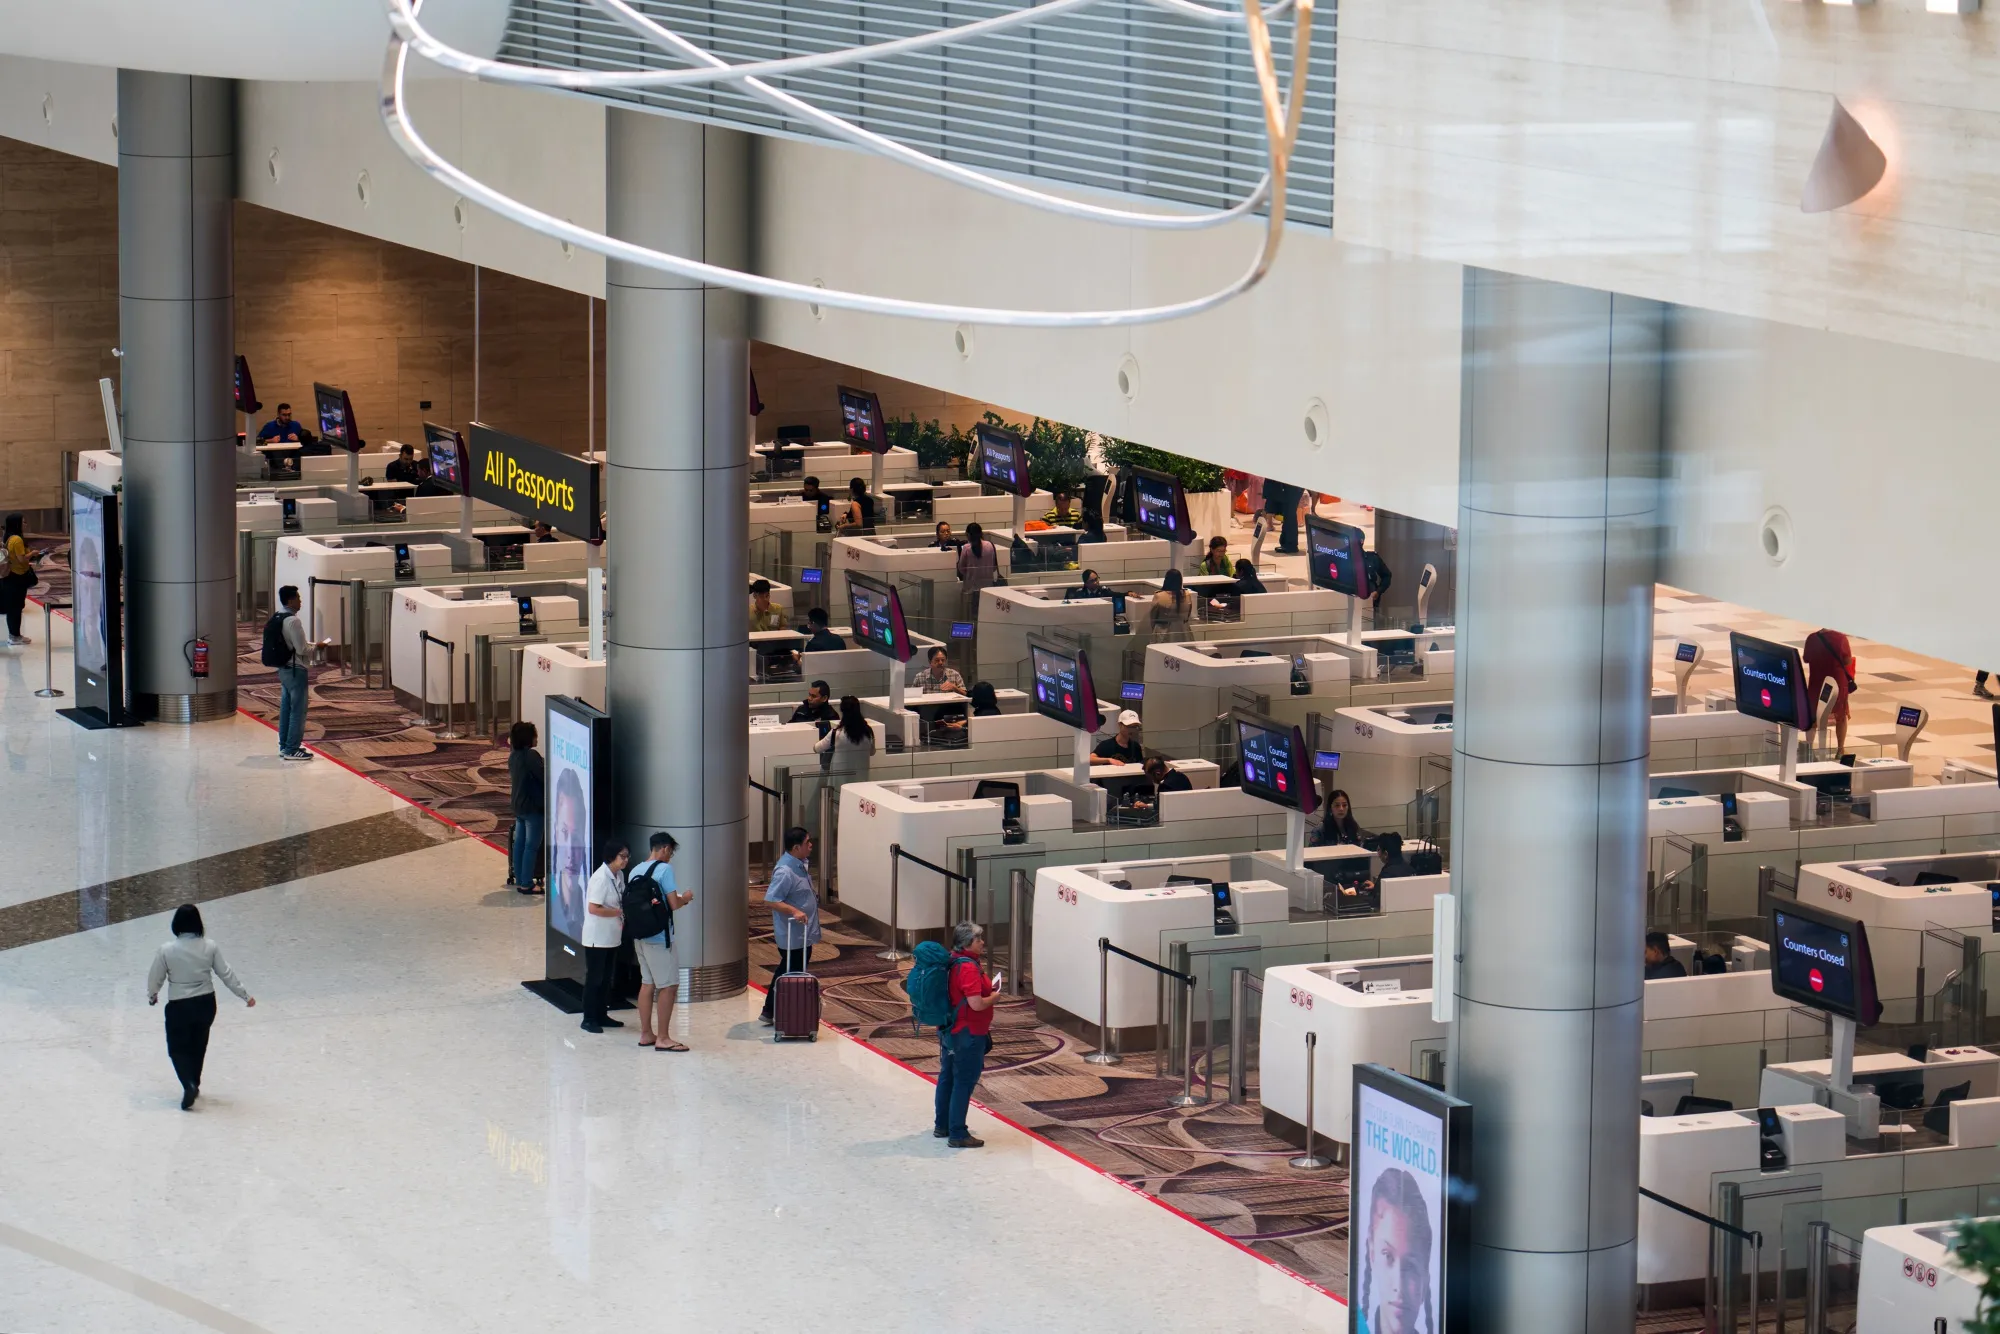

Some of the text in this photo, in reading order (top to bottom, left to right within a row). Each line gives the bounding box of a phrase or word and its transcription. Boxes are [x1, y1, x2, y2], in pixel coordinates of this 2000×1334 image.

[992, 449, 1011, 462] Passports
[484, 450, 575, 512] All Passports
[1142, 492, 1171, 508] All Passports
[1315, 543, 1348, 560] Counters Closed
[854, 596, 869, 607] Counter
[857, 606, 869, 617] Closed
[872, 612, 889, 625] Passports
[1037, 671, 1056, 685] Passports
[1058, 668, 1074, 681] Counter
[1743, 666, 1786, 686] Counters Closed
[1060, 680, 1074, 691] Closed
[553, 734, 565, 760] THE
[1250, 740, 1258, 749] All
[1244, 748, 1266, 763] Passports
[1268, 745, 1288, 759] Counter
[1271, 757, 1288, 770] Closed
[1783, 937, 1845, 967] Counters Closed
[1366, 1119, 1440, 1177] THE WORLD.
